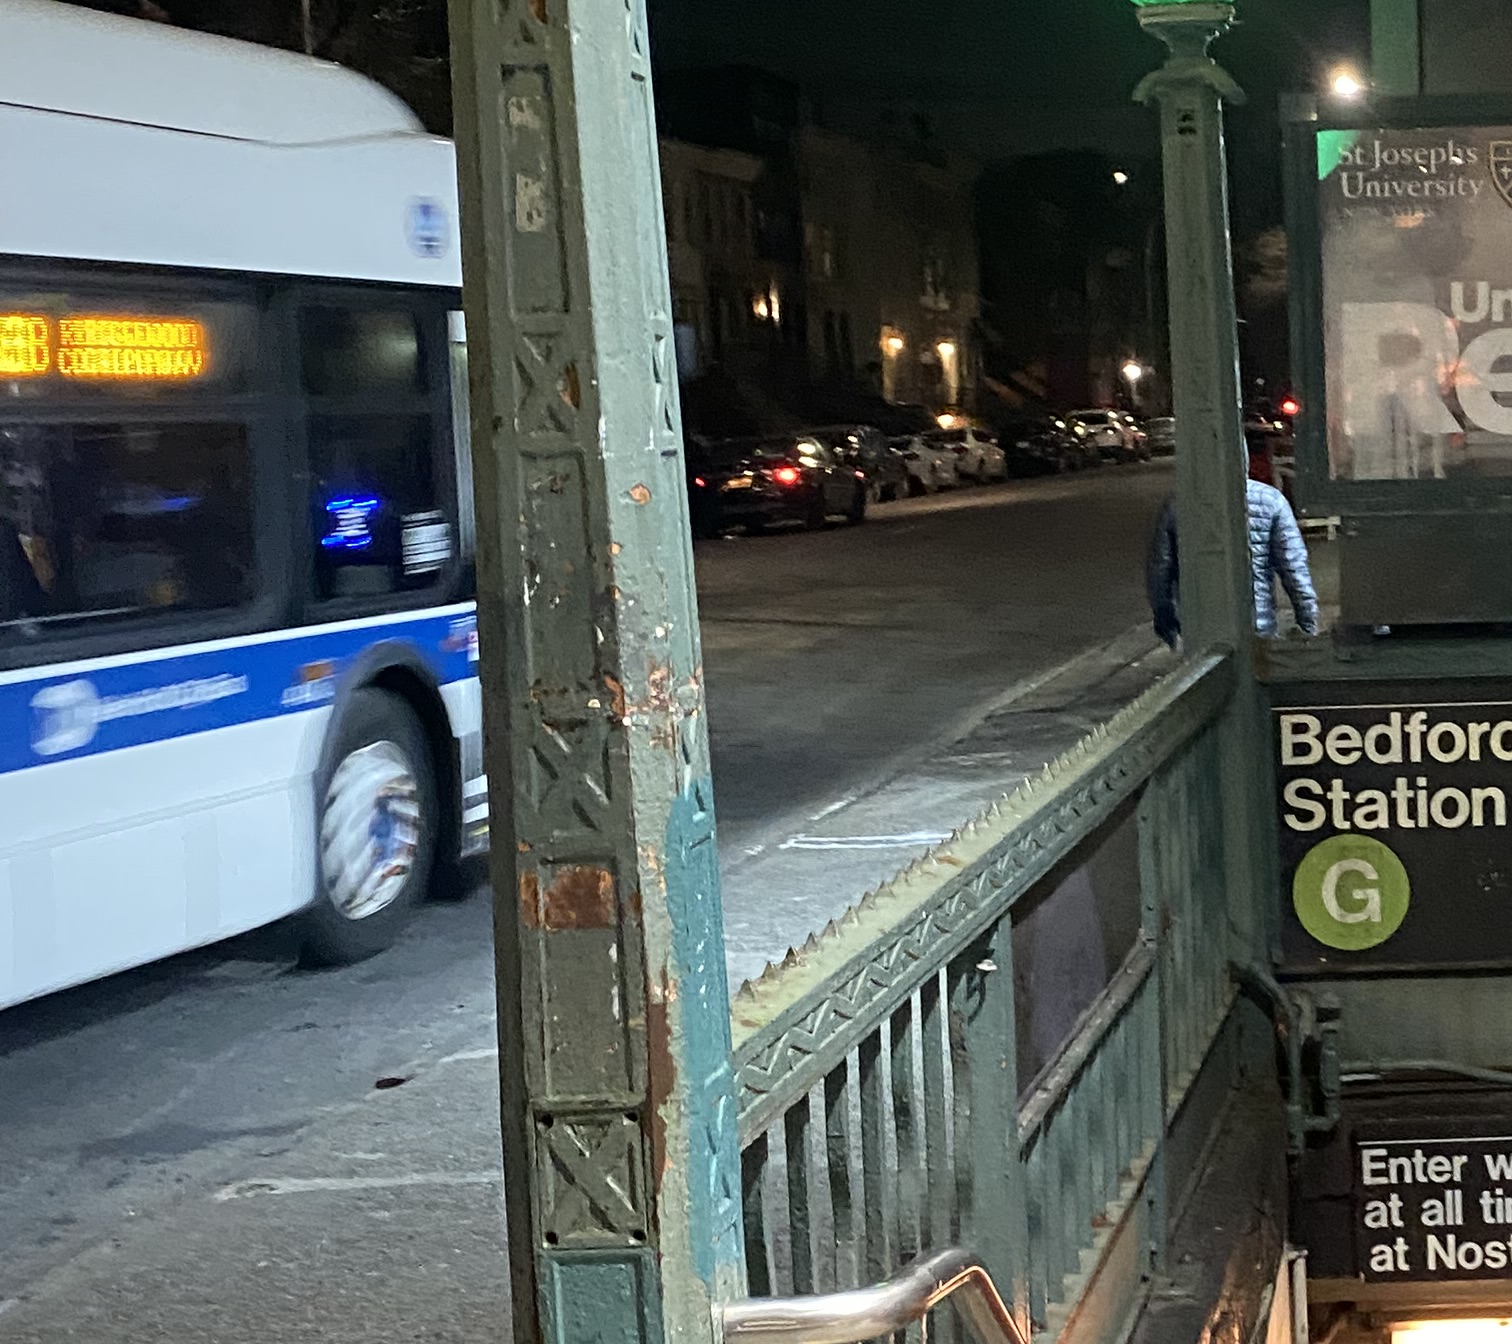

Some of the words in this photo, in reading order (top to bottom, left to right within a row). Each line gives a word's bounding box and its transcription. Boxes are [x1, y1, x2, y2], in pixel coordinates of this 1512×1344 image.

[1340, 169, 1484, 203] University
[1282, 775, 1507, 832] Station
[1320, 857, 1383, 924] G
[1361, 1148, 1468, 1185] Enter
[1363, 1192, 1405, 1229] at
[1420, 1189, 1463, 1226] all
[1369, 1236, 1411, 1273] at
